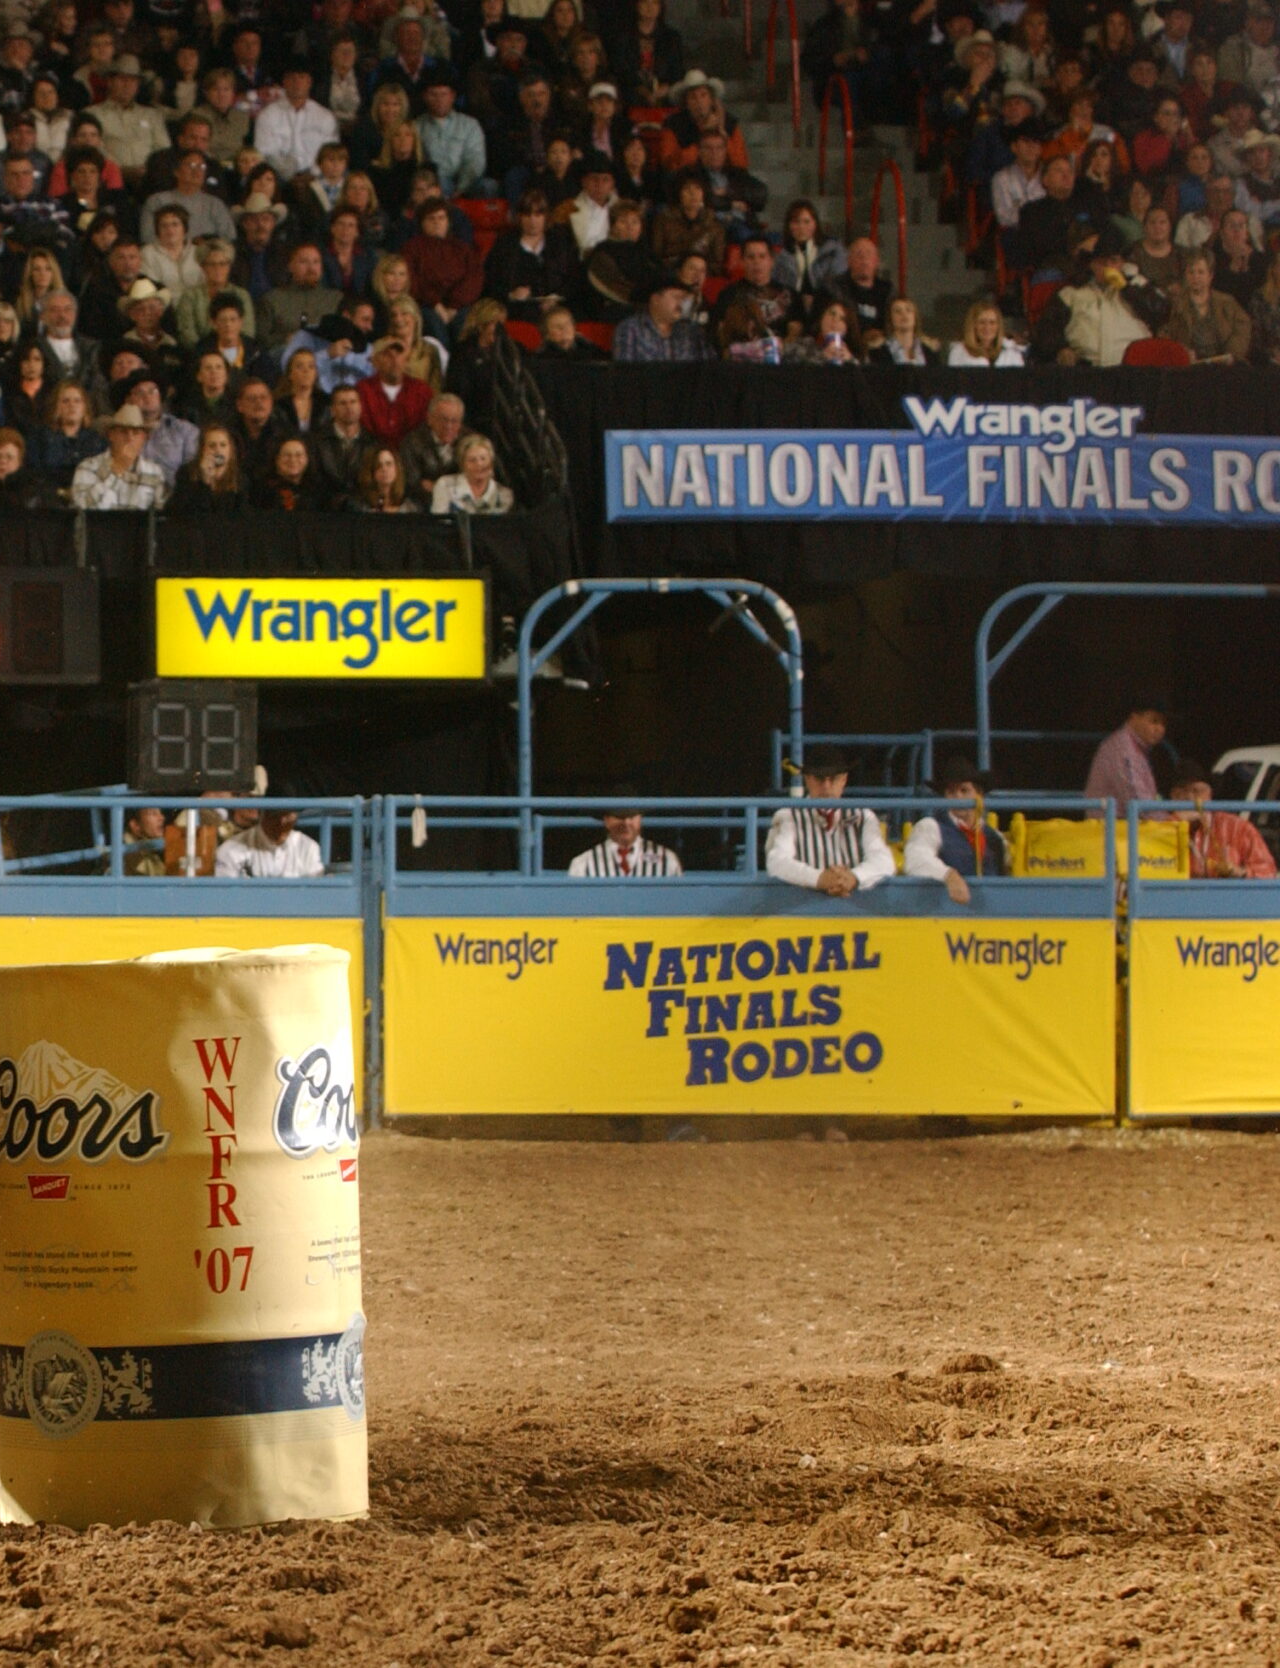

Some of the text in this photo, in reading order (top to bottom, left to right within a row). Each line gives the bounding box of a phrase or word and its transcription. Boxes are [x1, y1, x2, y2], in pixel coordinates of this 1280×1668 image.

[904, 397, 1142, 453] Wrangler
[622, 443, 944, 508] NATIONAL
[968, 445, 1191, 512] FINALS
[183, 588, 457, 669] Wrangler
[434, 932, 559, 981] Wrangler
[603, 932, 882, 990] NATIONAL
[944, 932, 1067, 981] Wrangler
[1175, 934, 1280, 982] Wrangle
[645, 984, 843, 1038] FINALS
[685, 1031, 884, 1086] RODEO
[194, 1245, 254, 1294] '07
